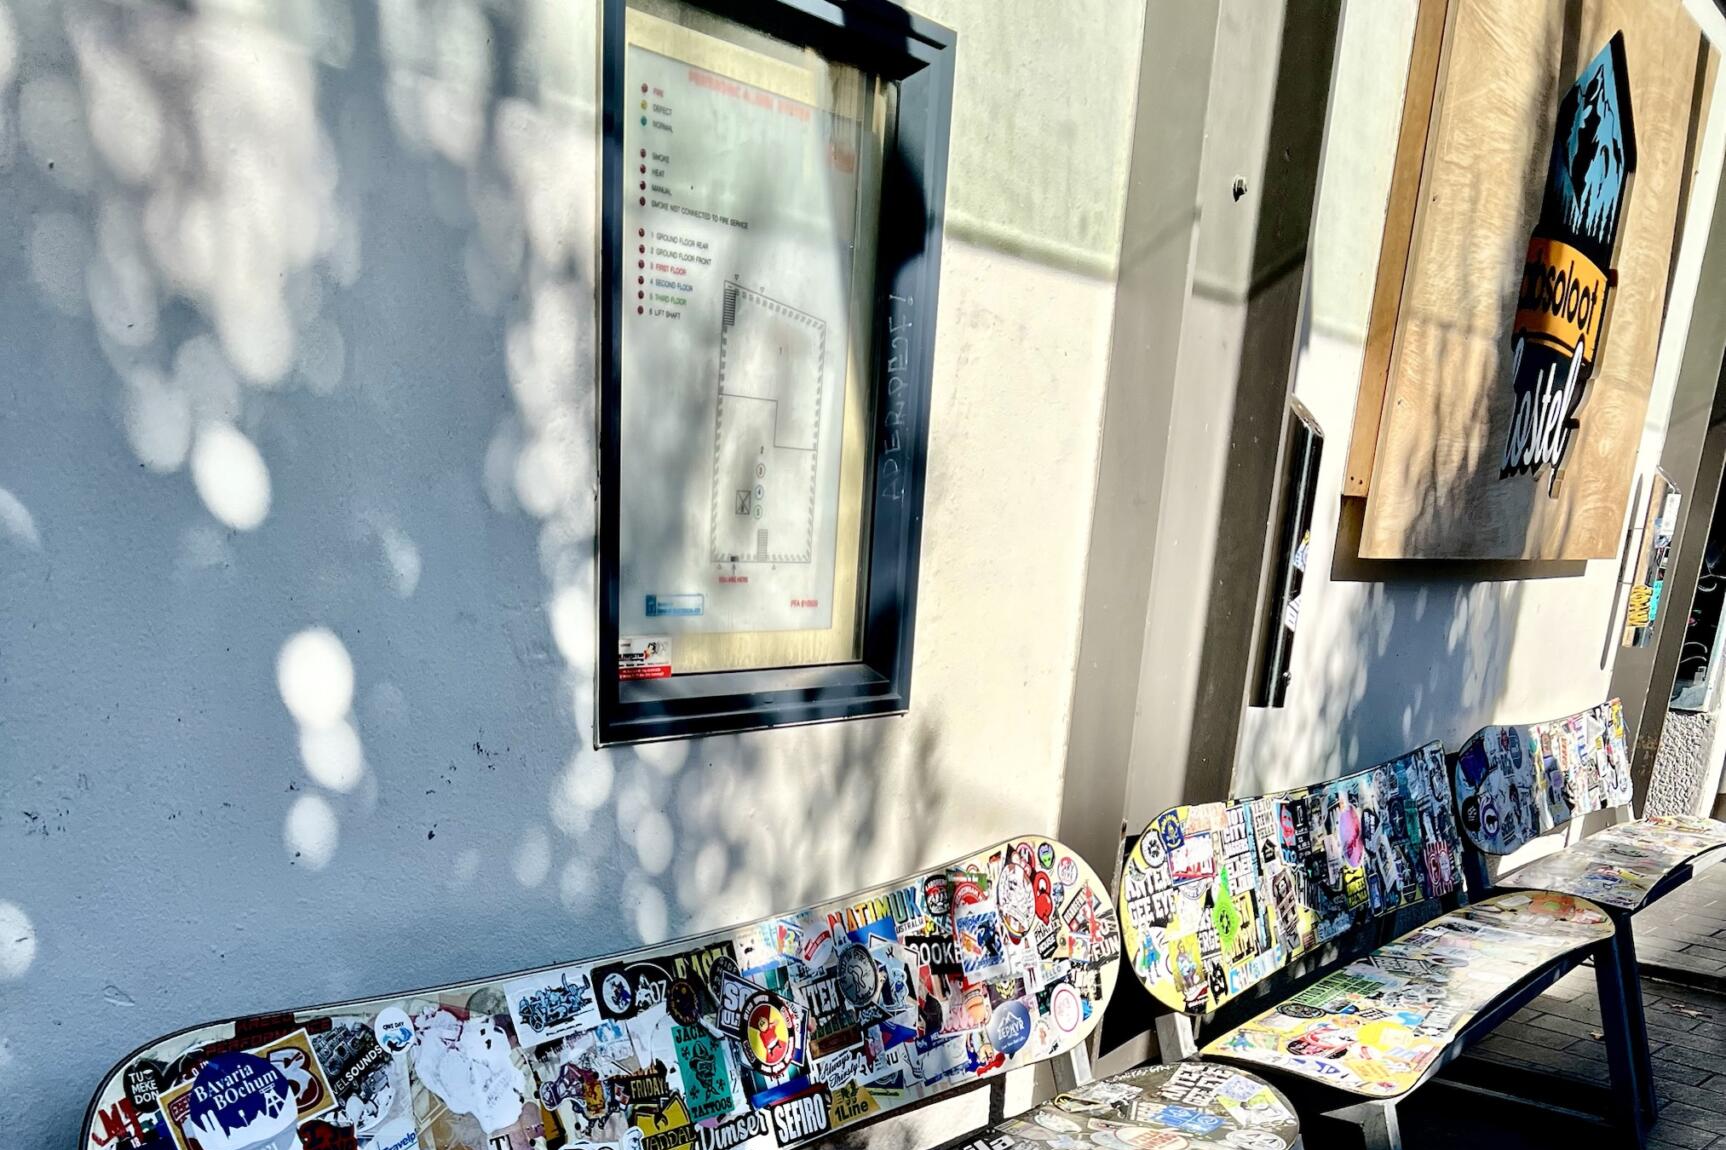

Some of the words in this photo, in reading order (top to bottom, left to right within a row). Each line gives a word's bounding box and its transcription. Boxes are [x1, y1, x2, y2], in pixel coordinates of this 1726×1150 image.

[681, 207, 711, 221] CONNECTED
[730, 219, 749, 230] SERVICE
[656, 232, 678, 244] GROUND
[679, 237, 695, 248] FLOOR
[696, 240, 709, 250] REAR
[655, 247, 678, 260] GROUND
[679, 253, 695, 263] FLOOR
[696, 256, 712, 266] FRONT
[656, 262, 669, 273] FIRST
[670, 266, 687, 276] FLOOR
[655, 278, 676, 290] SECOND
[677, 283, 693, 292] FLOOR
[655, 293, 669, 303] THIRD
[671, 296, 687, 305] FLOOR
[1519, 258, 1600, 336] absoloot
[666, 310, 681, 319] SHAFT
[997, 1018, 1025, 1037] ZEPHYR
[131, 1080, 157, 1096] MEKE
[193, 1062, 255, 1102] BAvaria
[212, 1069, 279, 1111] BOchum
[134, 1092, 159, 1105] DON
[774, 1093, 827, 1143] SEFIRO
[834, 1101, 869, 1122] 1Line
